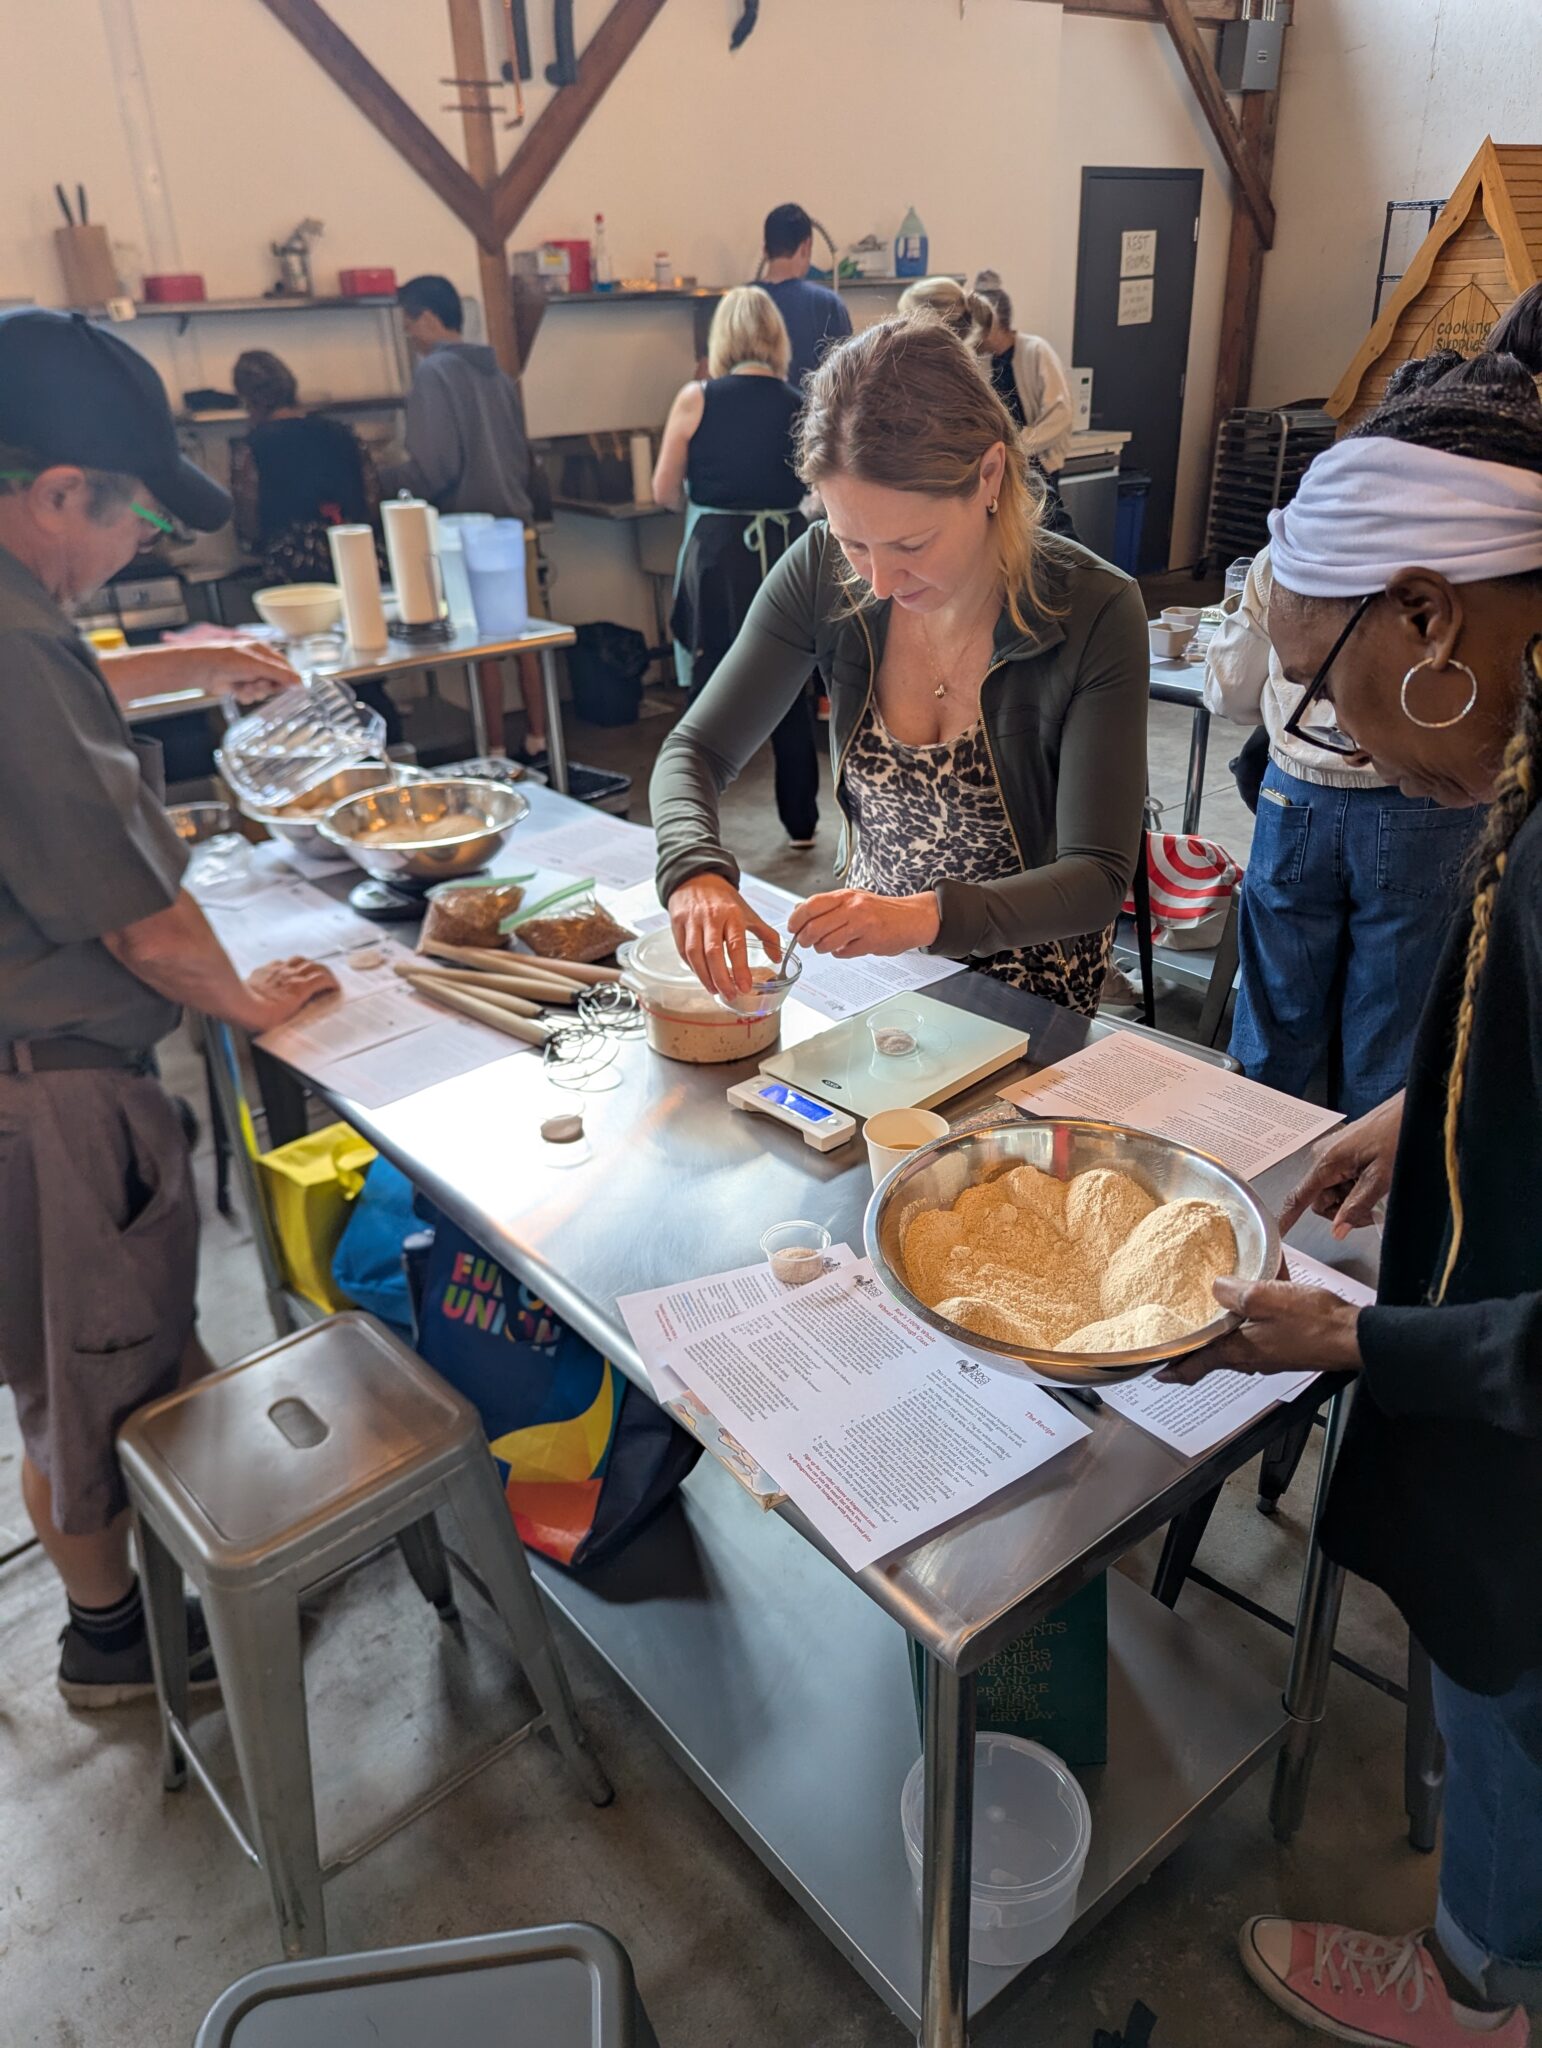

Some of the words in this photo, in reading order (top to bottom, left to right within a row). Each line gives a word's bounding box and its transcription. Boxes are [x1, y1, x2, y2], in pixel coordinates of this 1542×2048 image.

[1024, 1411, 1037, 1422] The
[1035, 1419, 1056, 1436] Recipe
[1002, 1660, 1053, 1677] KNOW
[994, 1676, 1030, 1687] AND
[977, 1683, 1049, 1697] PREPARE
